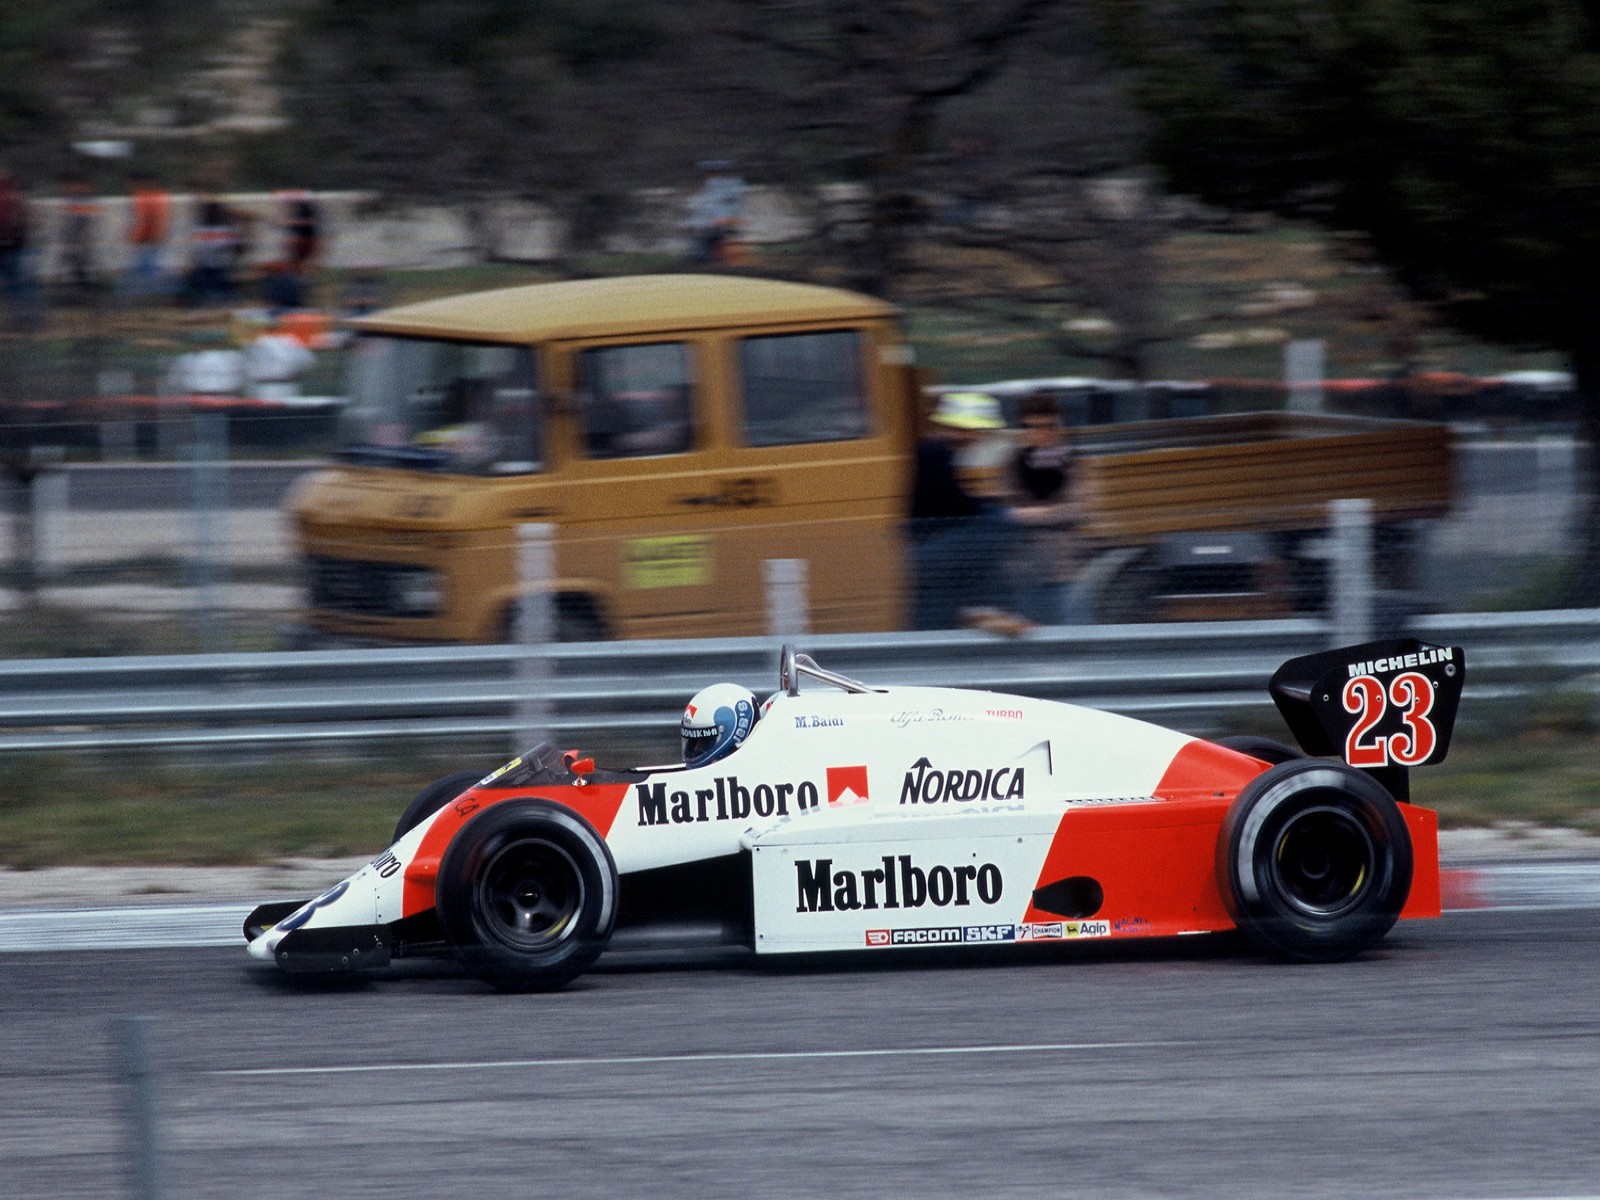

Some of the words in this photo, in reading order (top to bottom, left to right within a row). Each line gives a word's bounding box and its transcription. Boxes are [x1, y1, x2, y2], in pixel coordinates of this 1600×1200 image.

[1348, 647, 1453, 677] MICHELIN
[1342, 672, 1437, 768] 23
[900, 759, 1025, 805] NORDICA
[636, 776, 819, 827] Marlboro
[795, 855, 1003, 913] Marlboro
[893, 928, 960, 943] FACOM
[966, 925, 1013, 941] SKF
[1034, 927, 1061, 935] CHAMPION
[1080, 922, 1107, 936] Agip
